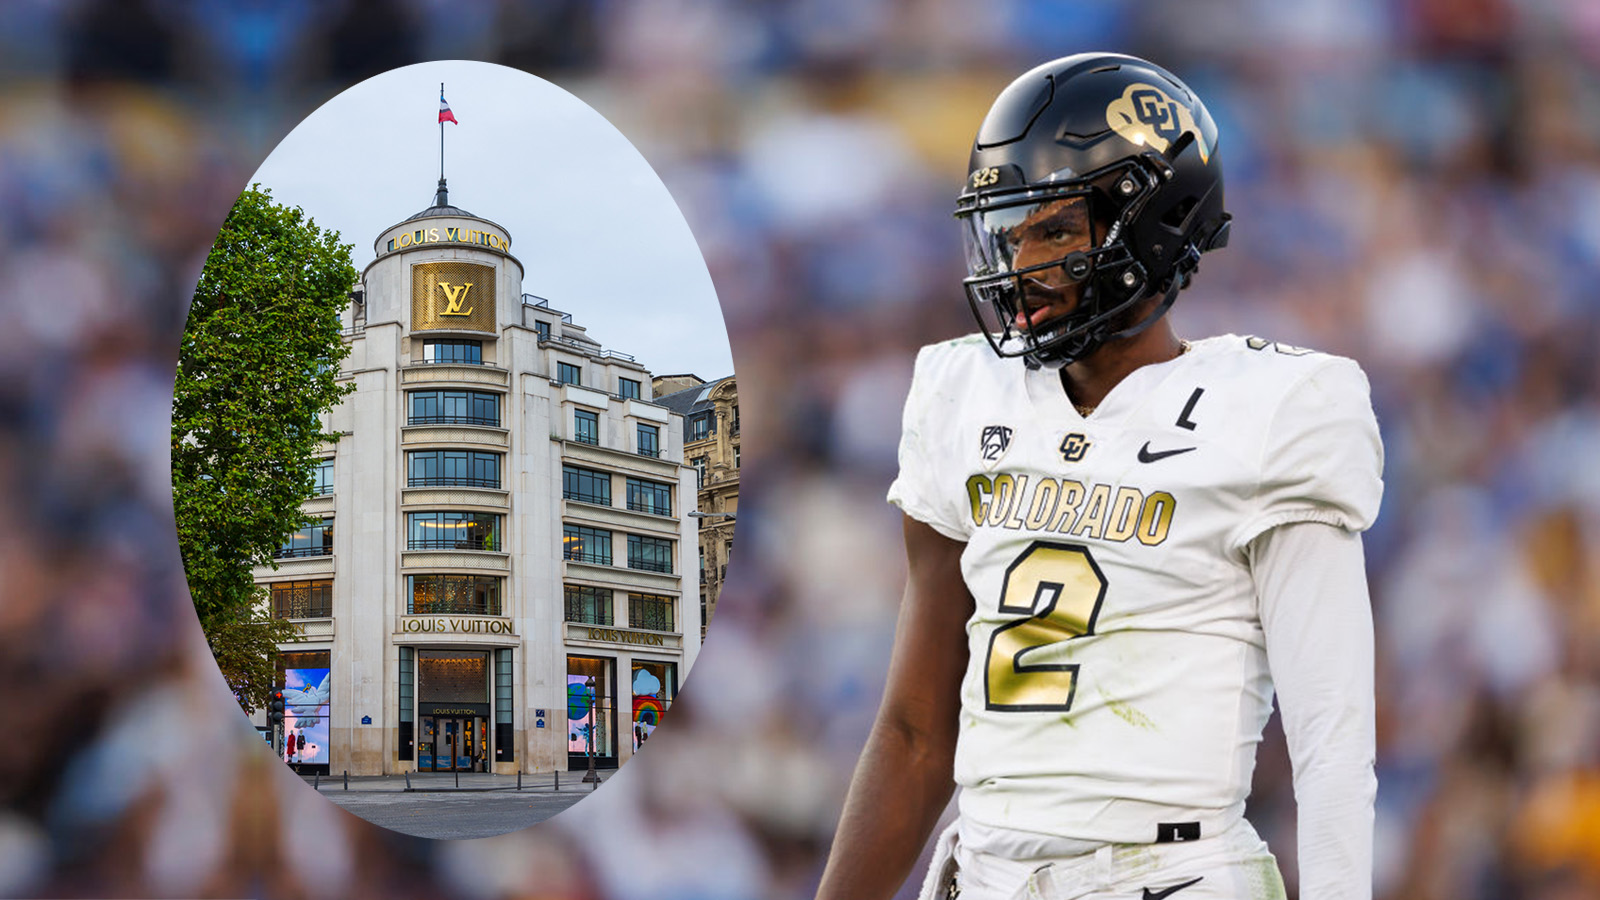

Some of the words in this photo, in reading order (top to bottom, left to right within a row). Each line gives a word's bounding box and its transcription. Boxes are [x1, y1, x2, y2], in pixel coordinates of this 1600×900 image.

[393, 228, 440, 250] LOUIS
[444, 228, 509, 253] VUITTON
[438, 282, 473, 316] LV
[1175, 387, 1205, 431] L
[980, 425, 1013, 452] PAC
[983, 443, 1001, 461] 12
[1059, 433, 1091, 462] CU
[966, 474, 1177, 547] COLORADO
[402, 618, 446, 632] LOUIS
[449, 619, 513, 634] VUITTON
[588, 628, 618, 642] LOUIS
[620, 631, 663, 646] VUITTON
[985, 540, 1109, 712] 2
[1173, 828, 1184, 841] L
